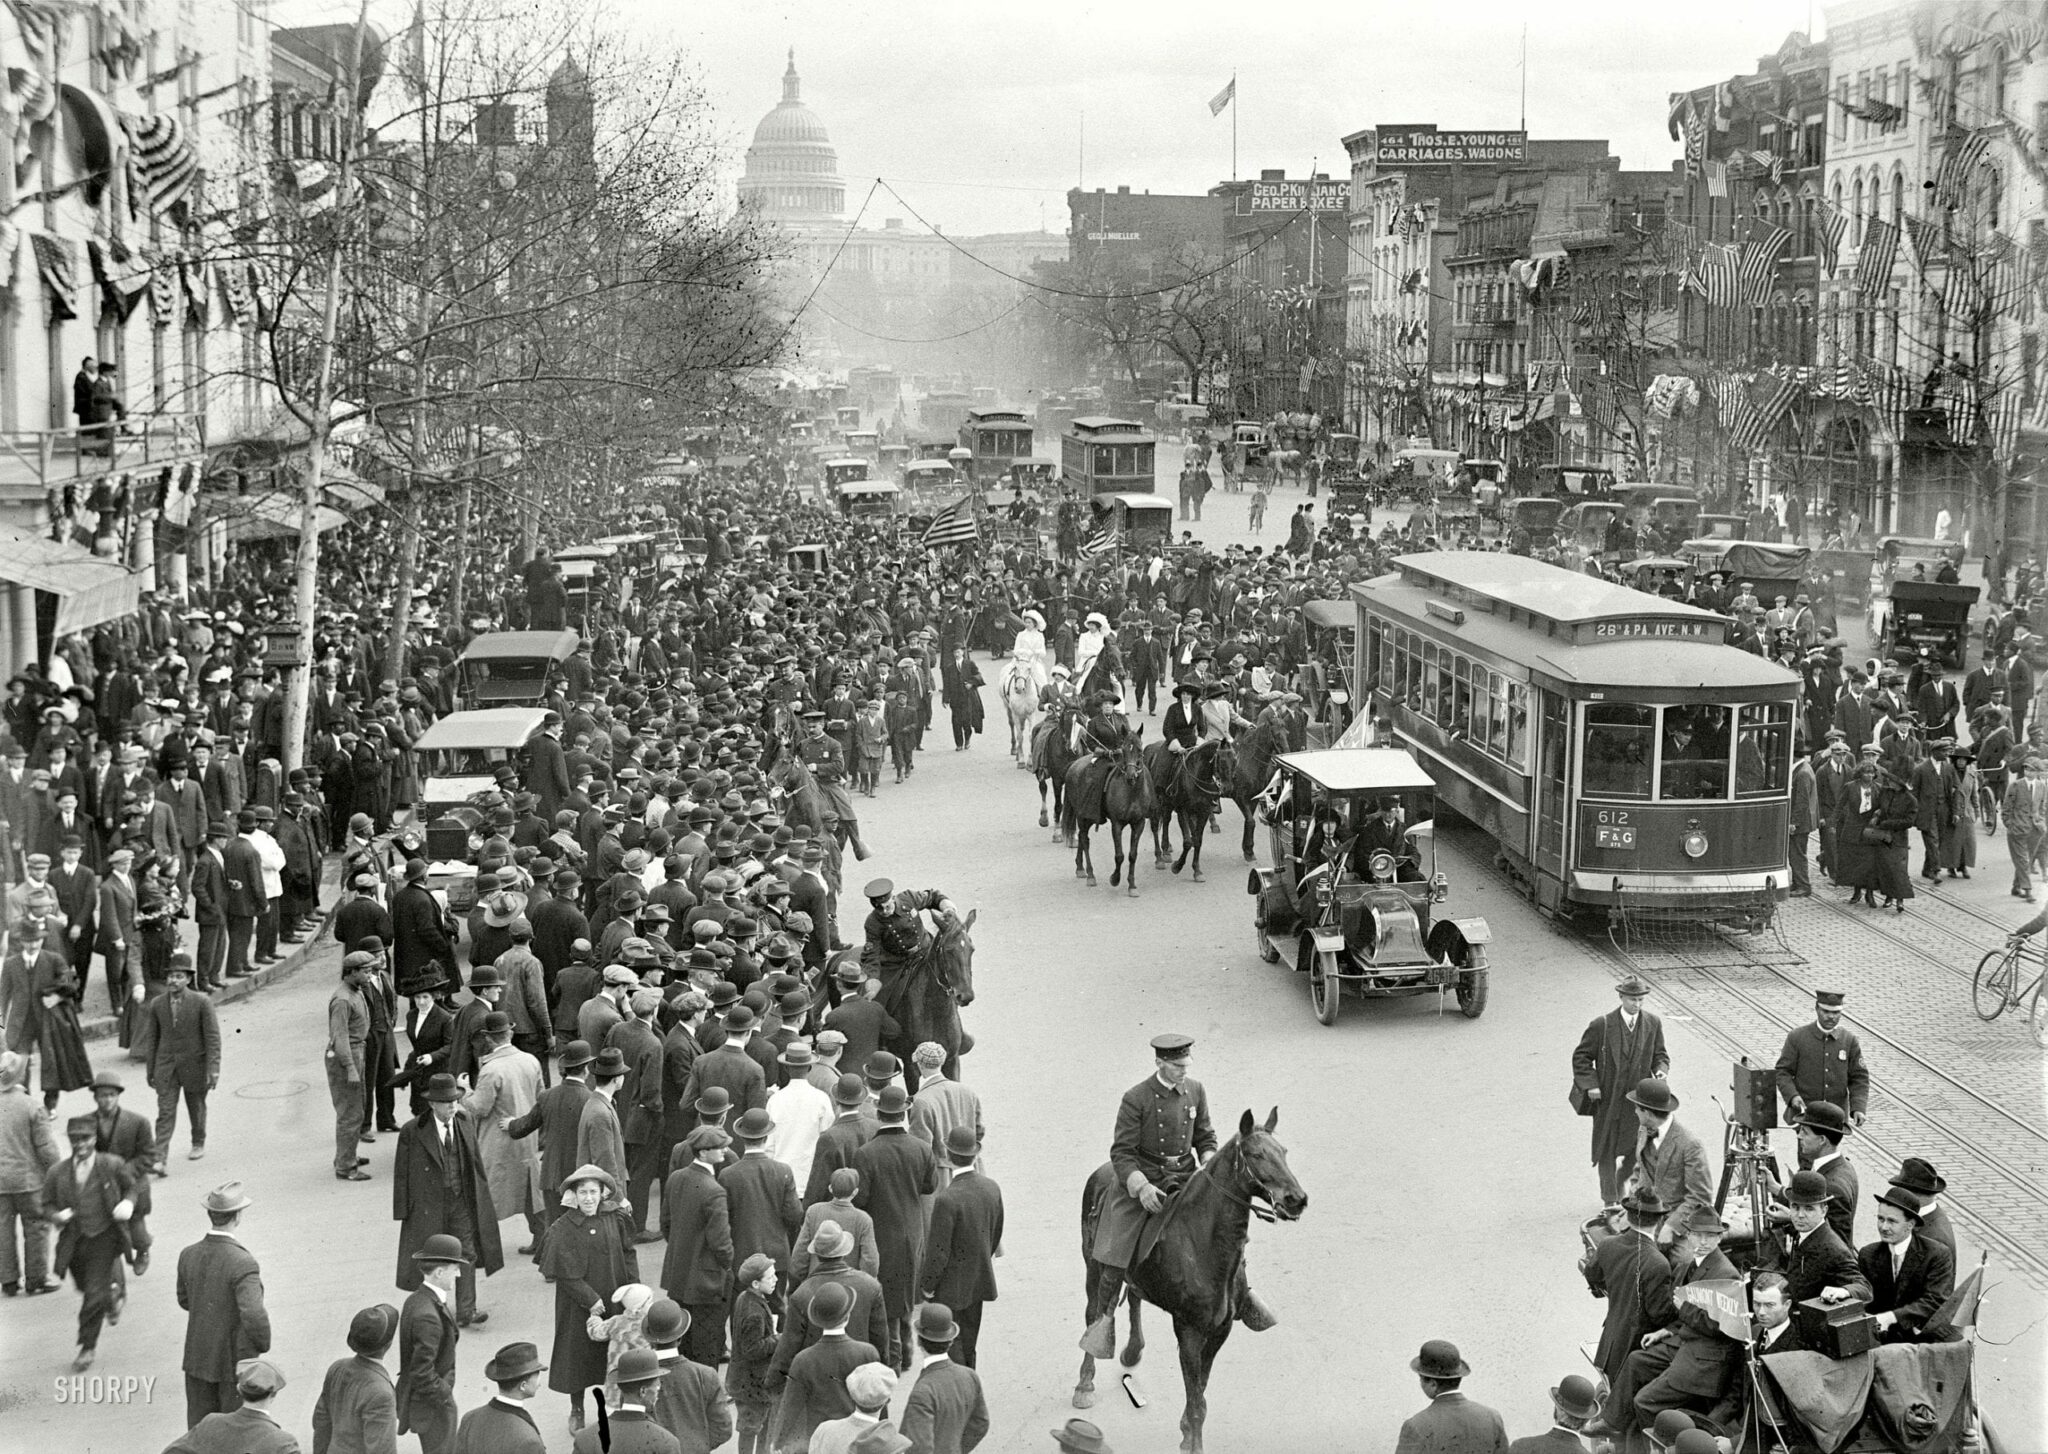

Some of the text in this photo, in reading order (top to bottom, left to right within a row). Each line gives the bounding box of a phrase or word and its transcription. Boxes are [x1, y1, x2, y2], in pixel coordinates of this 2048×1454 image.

[1380, 136, 1404, 145] 464
[1252, 198, 1297, 209] PAPER
[1623, 624, 1630, 636] &
[1598, 811, 1629, 824] 612
[1600, 831, 1632, 843] F & G
[1685, 1286, 1738, 1317] GAUMONT WEEKLY
